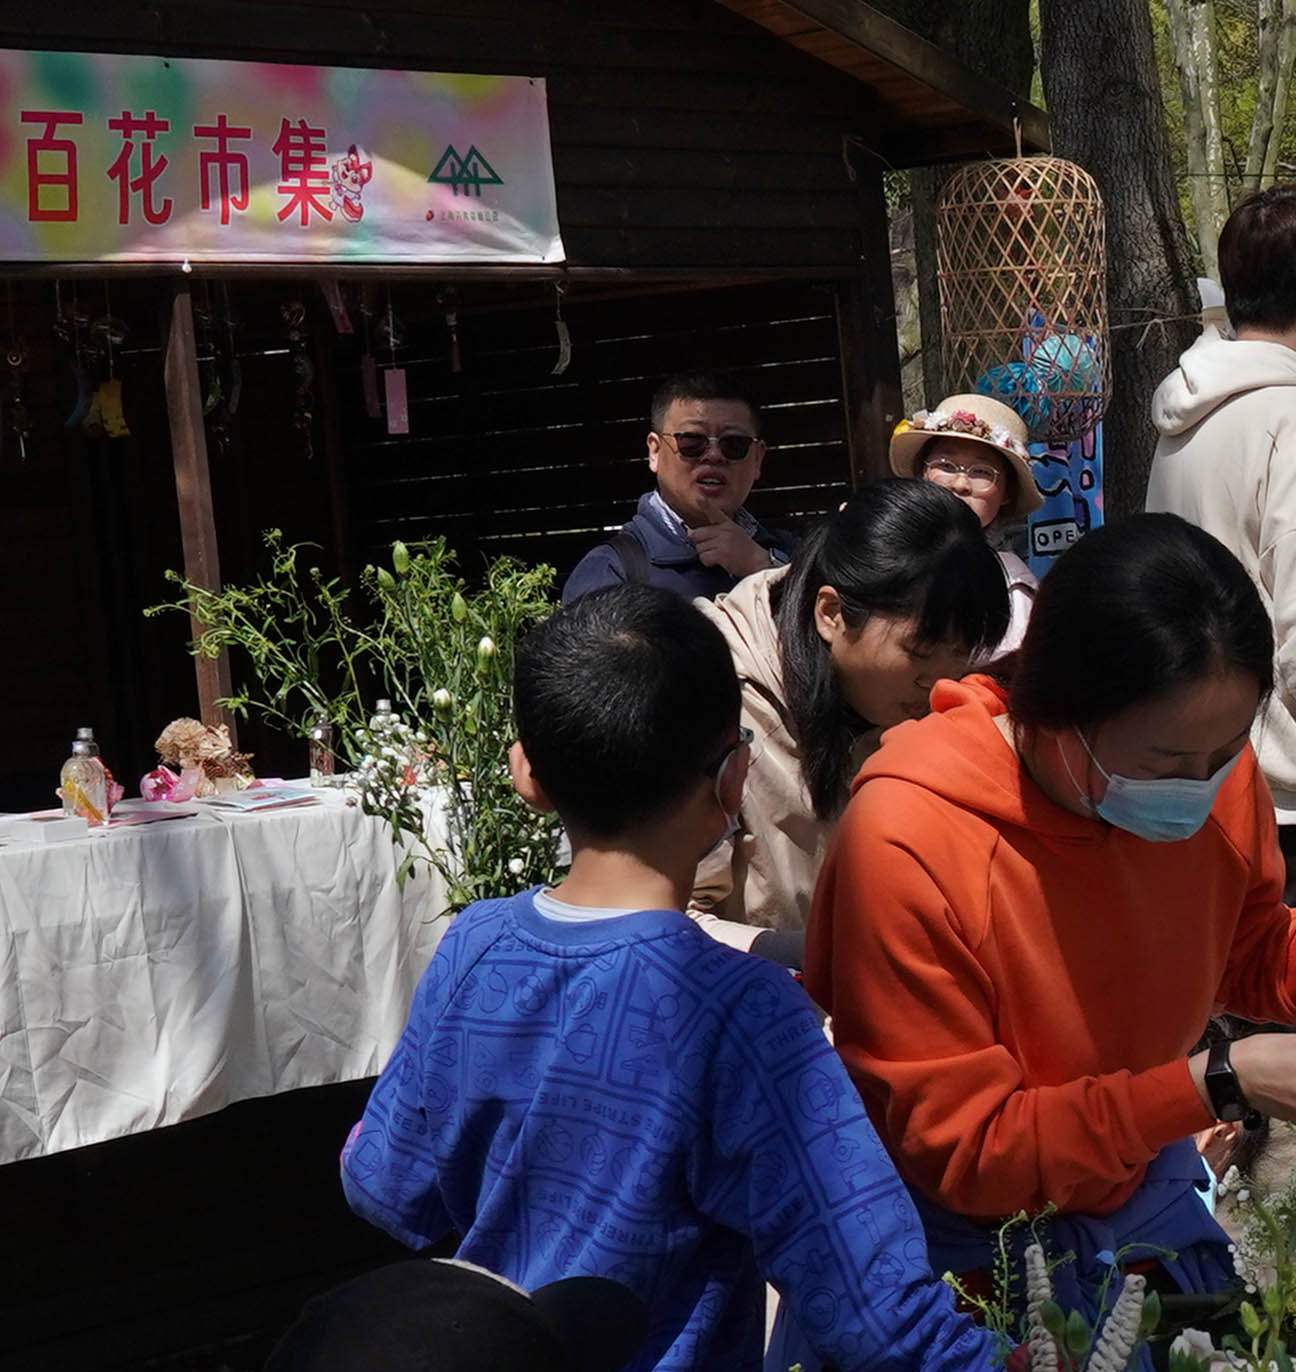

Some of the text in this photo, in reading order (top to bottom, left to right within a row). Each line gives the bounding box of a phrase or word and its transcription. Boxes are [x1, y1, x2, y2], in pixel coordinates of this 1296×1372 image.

[20, 110, 334, 227] 百花市集
[1037, 529, 1083, 546] OPE
